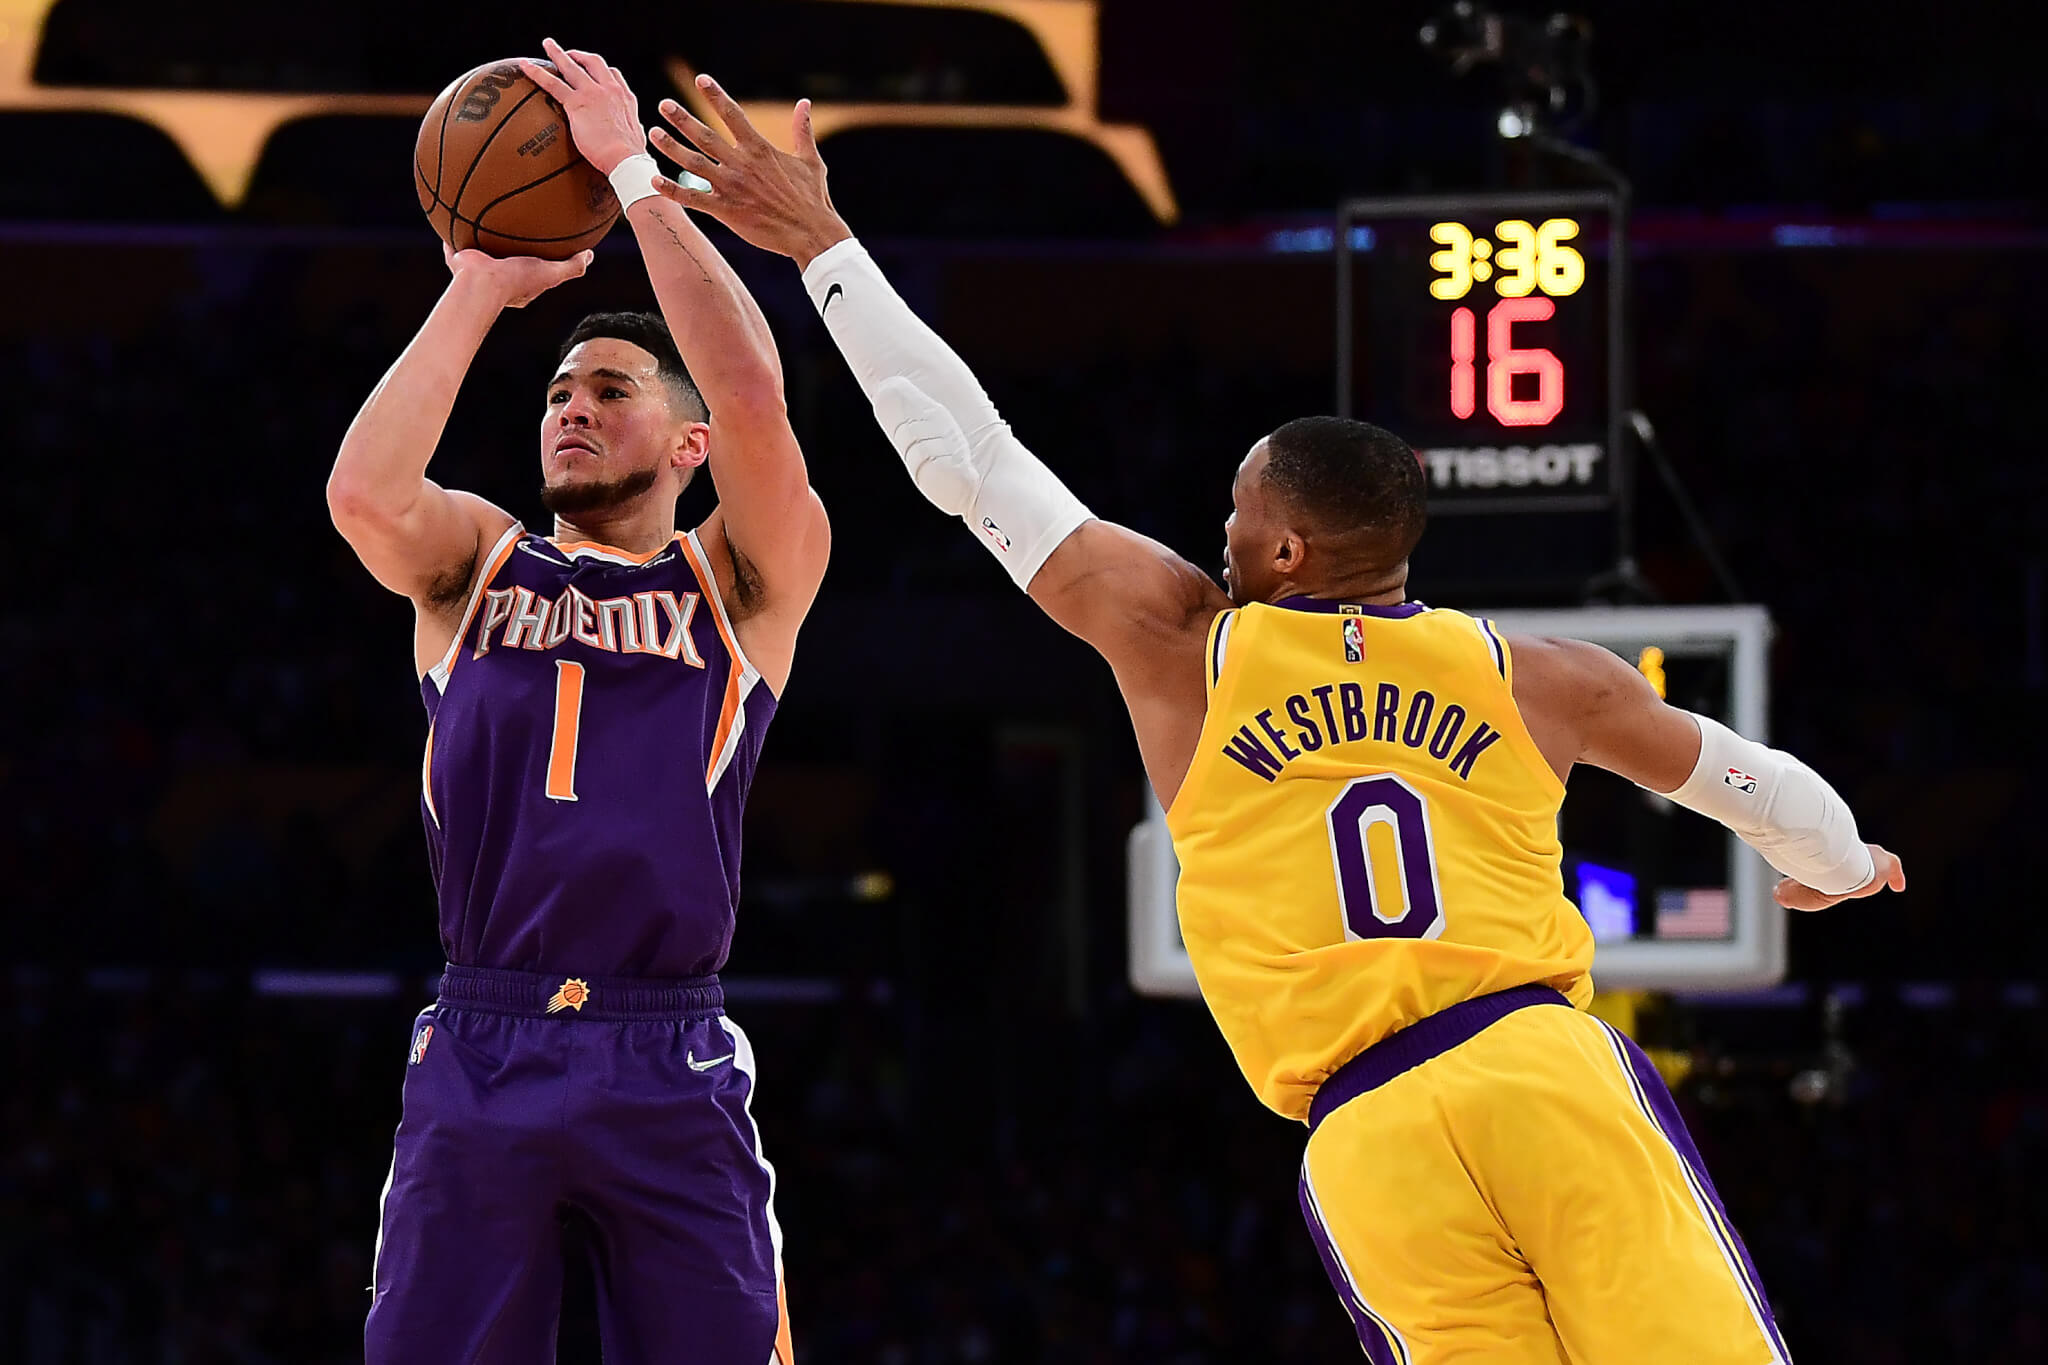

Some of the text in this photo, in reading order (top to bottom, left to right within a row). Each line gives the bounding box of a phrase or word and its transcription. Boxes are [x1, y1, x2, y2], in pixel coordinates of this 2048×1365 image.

[1429, 218, 1585, 300] 3:36
[1450, 296, 1564, 427] 16
[1423, 443, 1604, 488] TISSOT
[473, 584, 705, 669] PHOENIX
[545, 659, 586, 802] 1
[1221, 681, 1501, 783] WESTBROOK
[1325, 772, 1446, 942] 0
